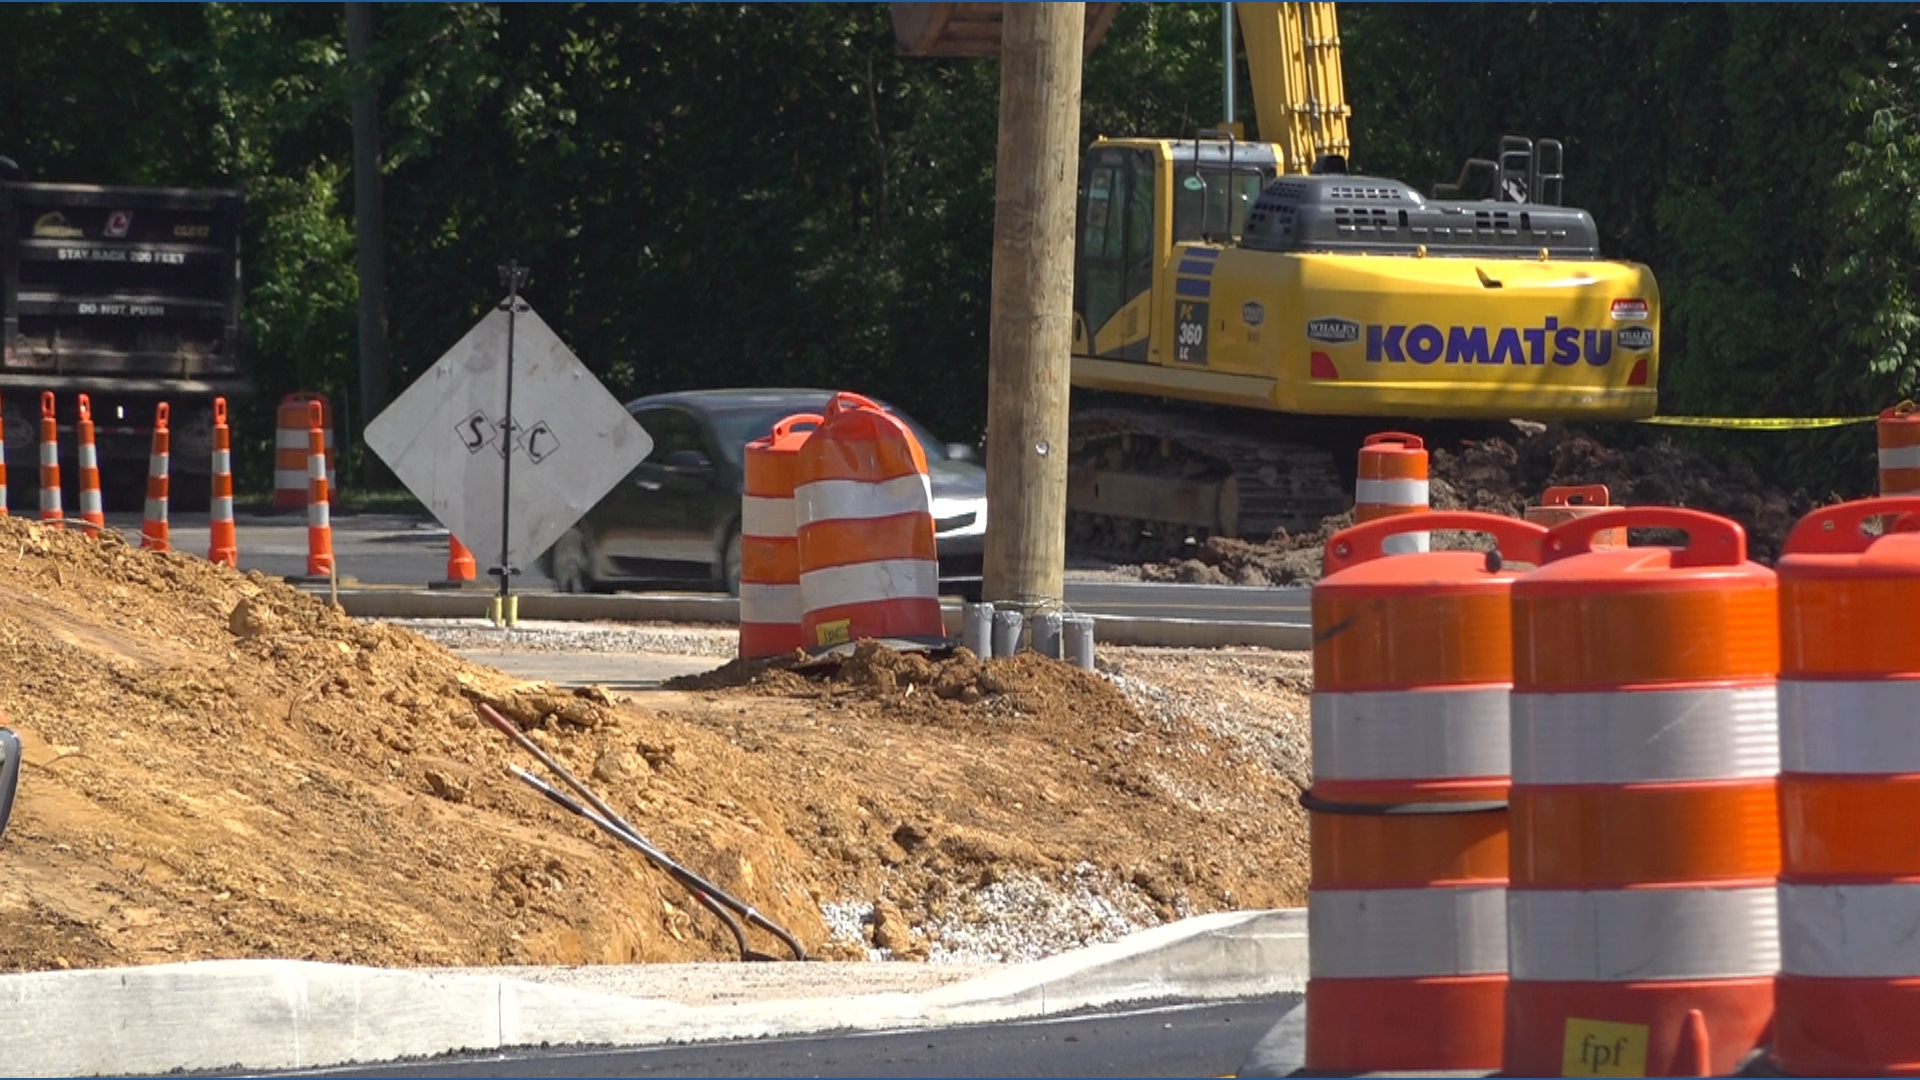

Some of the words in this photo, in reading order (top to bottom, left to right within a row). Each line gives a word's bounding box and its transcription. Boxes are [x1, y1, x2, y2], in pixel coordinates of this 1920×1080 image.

[58, 249, 89, 260] STAY
[92, 250, 127, 261] BACK
[155, 252, 185, 264] FEET
[79, 303, 97, 314] DO
[101, 304, 126, 315] NOT
[130, 305, 164, 316] PUSH
[1180, 304, 1193, 320] PC
[1179, 322, 1202, 345] 360
[1309, 322, 1357, 333] WHALEY
[1366, 316, 1613, 366] KOMATSU
[1179, 346, 1189, 360] LC
[1581, 1033, 1628, 1074] fpf
